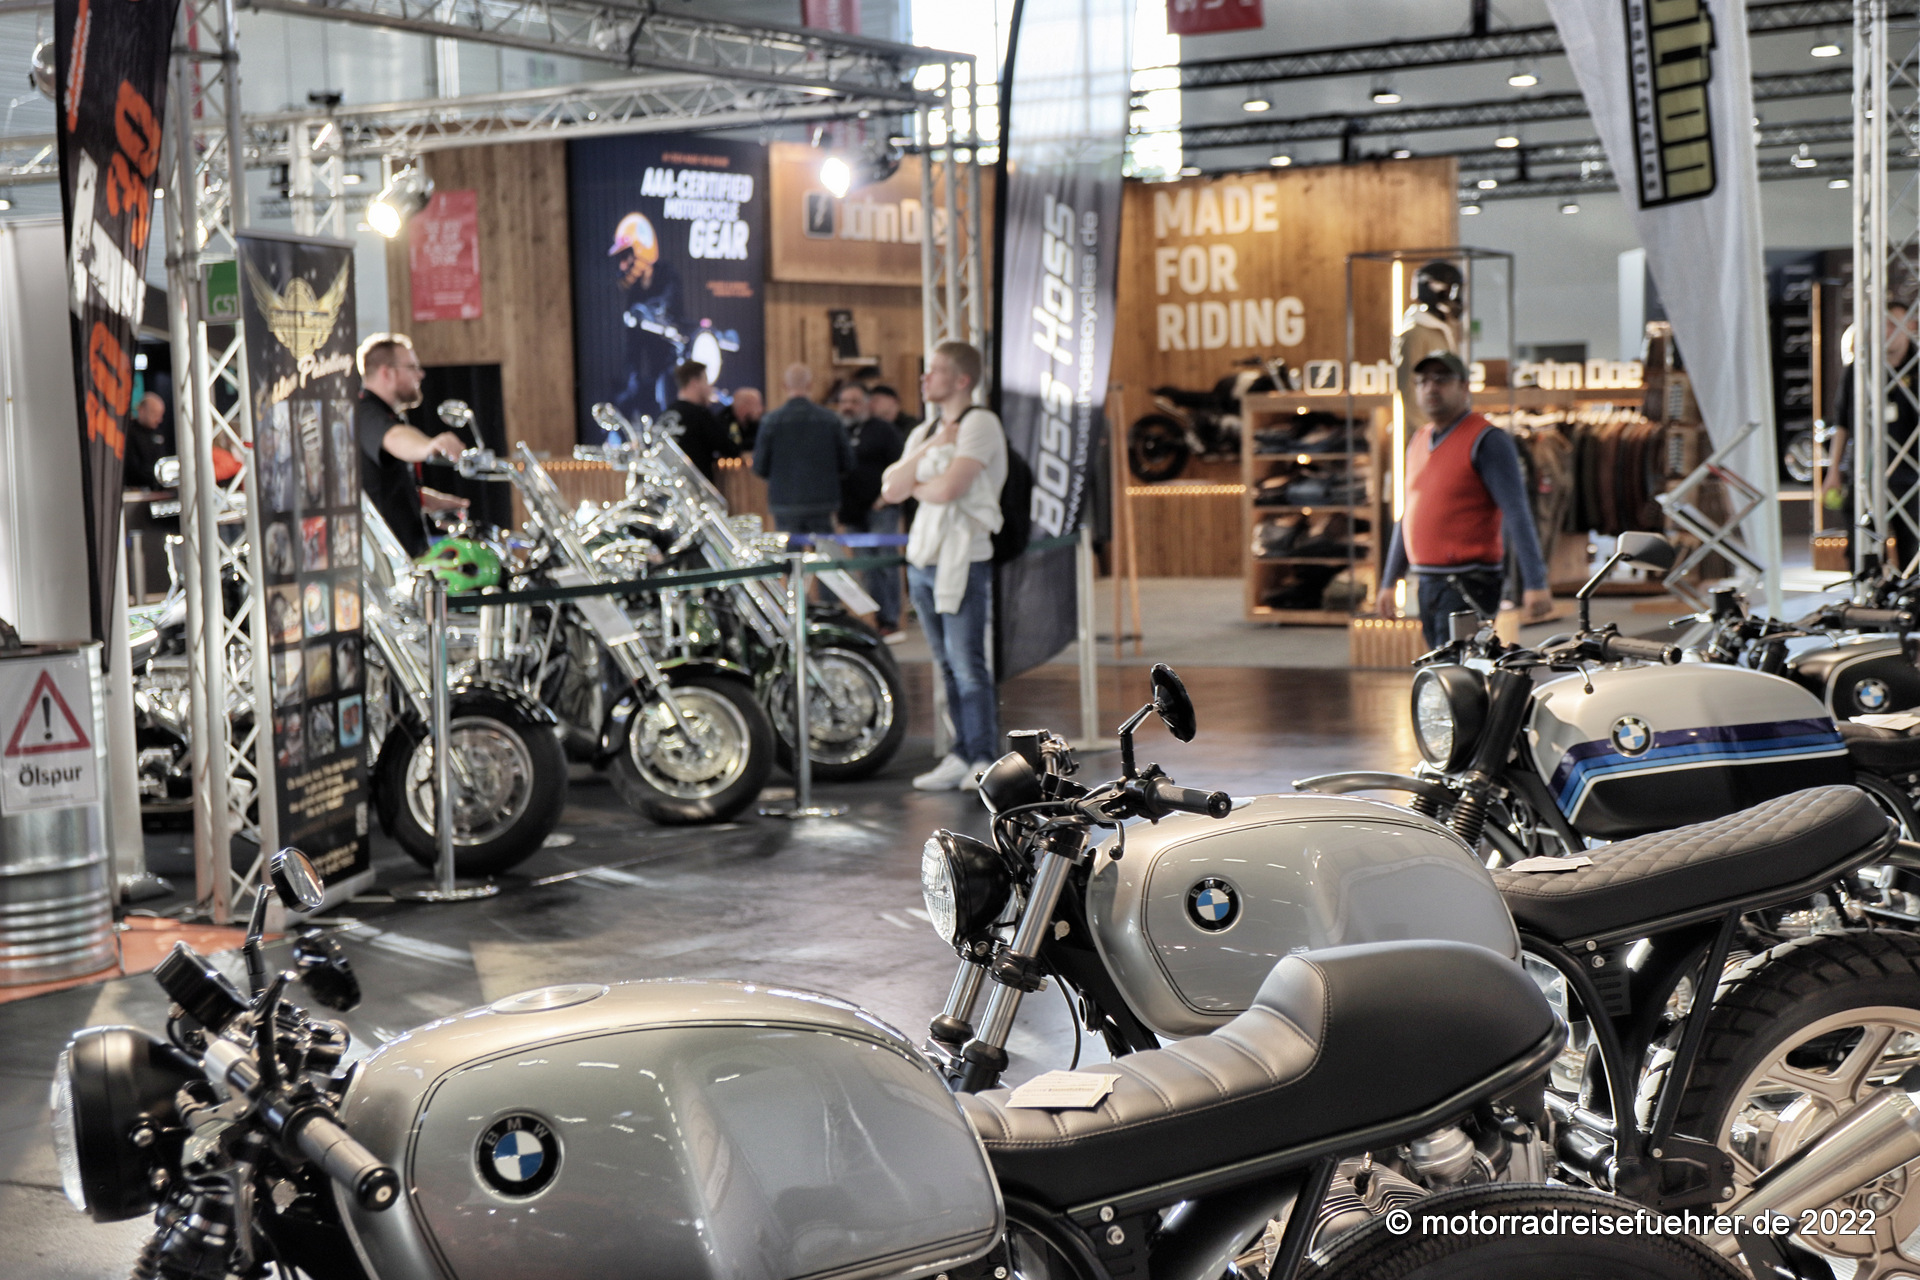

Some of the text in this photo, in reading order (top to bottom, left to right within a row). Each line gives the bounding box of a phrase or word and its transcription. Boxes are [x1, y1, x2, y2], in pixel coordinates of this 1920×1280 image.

[1631, 4, 1660, 191] motorcycles
[663, 197, 740, 222] MOTORCYCLE
[1153, 182, 1279, 239] MADE
[688, 219, 749, 260] GEAR
[1155, 244, 1238, 296] FOR
[1156, 296, 1306, 351] RIDING
[1349, 358, 1398, 395] Joh
[1585, 358, 1644, 390] Doe
[19, 763, 82, 788] Ölspur
[1190, 880, 1233, 898] BMW
[484, 1118, 549, 1147] BMW
